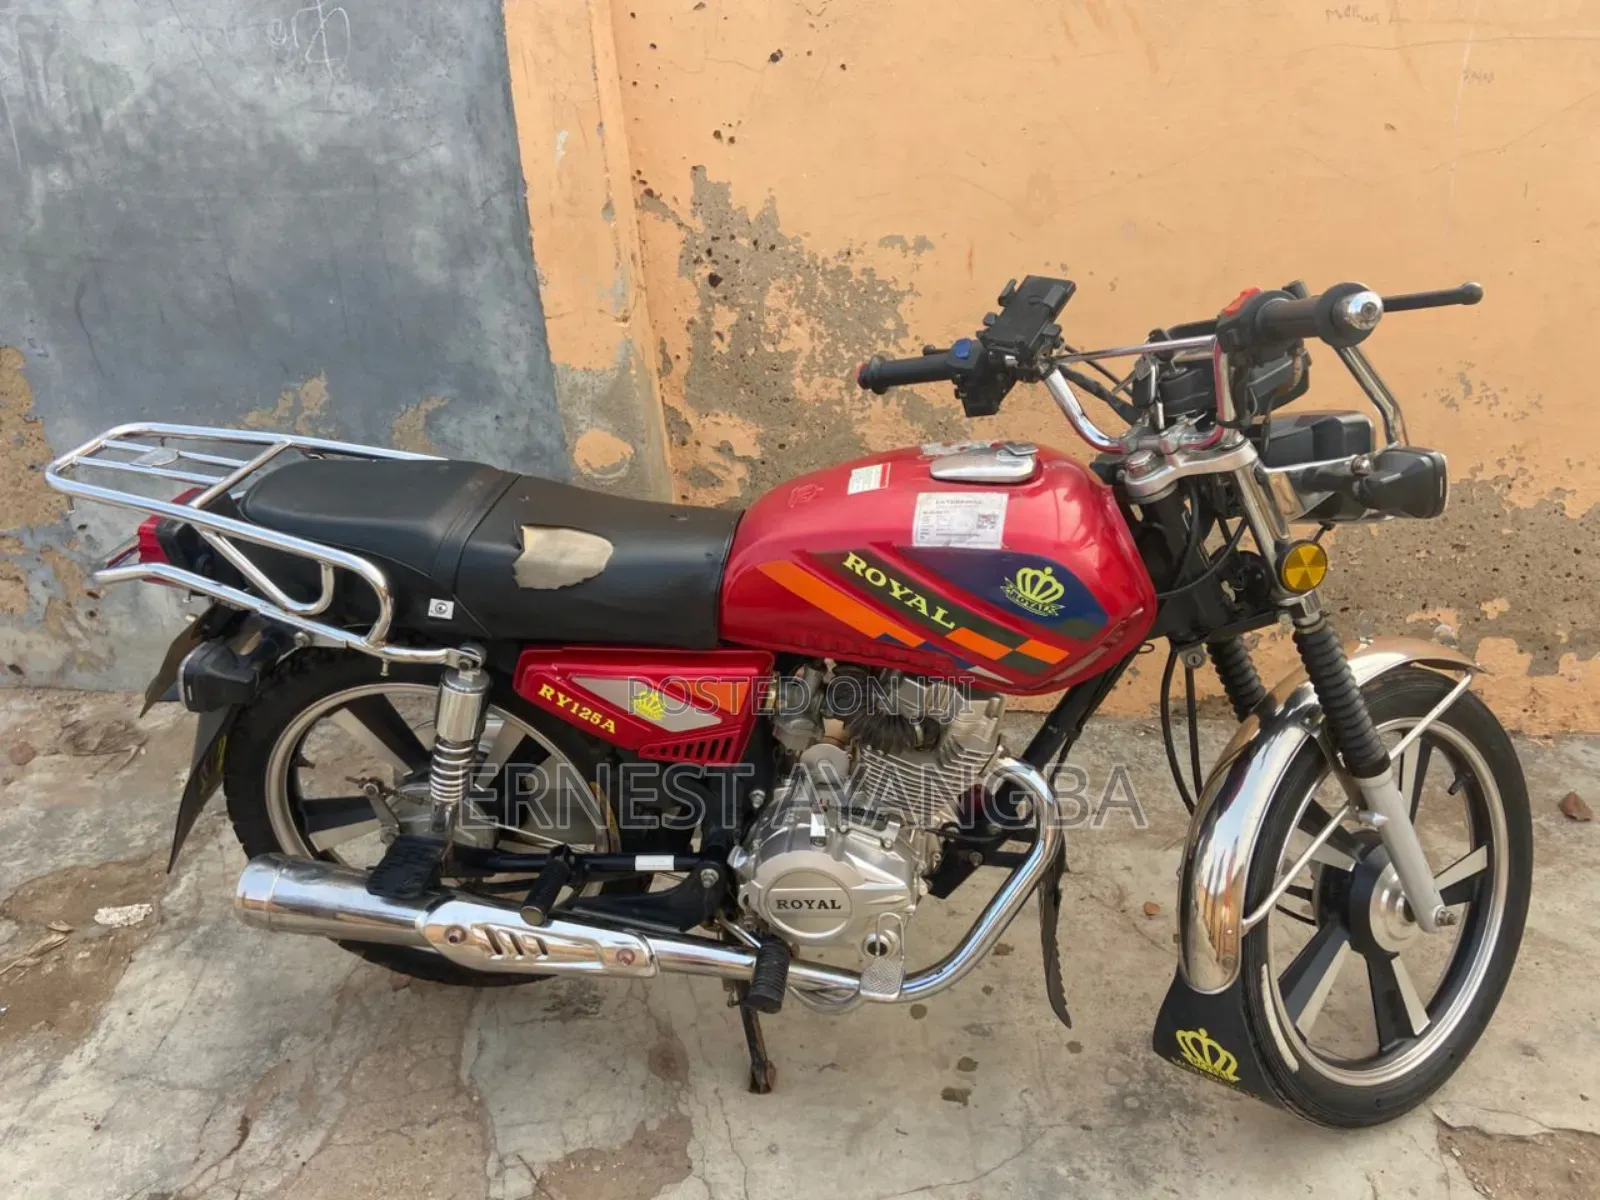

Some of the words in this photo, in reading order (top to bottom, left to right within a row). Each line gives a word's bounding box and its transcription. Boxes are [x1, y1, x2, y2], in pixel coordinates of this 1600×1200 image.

[842, 551, 956, 630] ROYAL
[537, 683, 617, 734] RY125A
[776, 899, 842, 910] ROYAL
